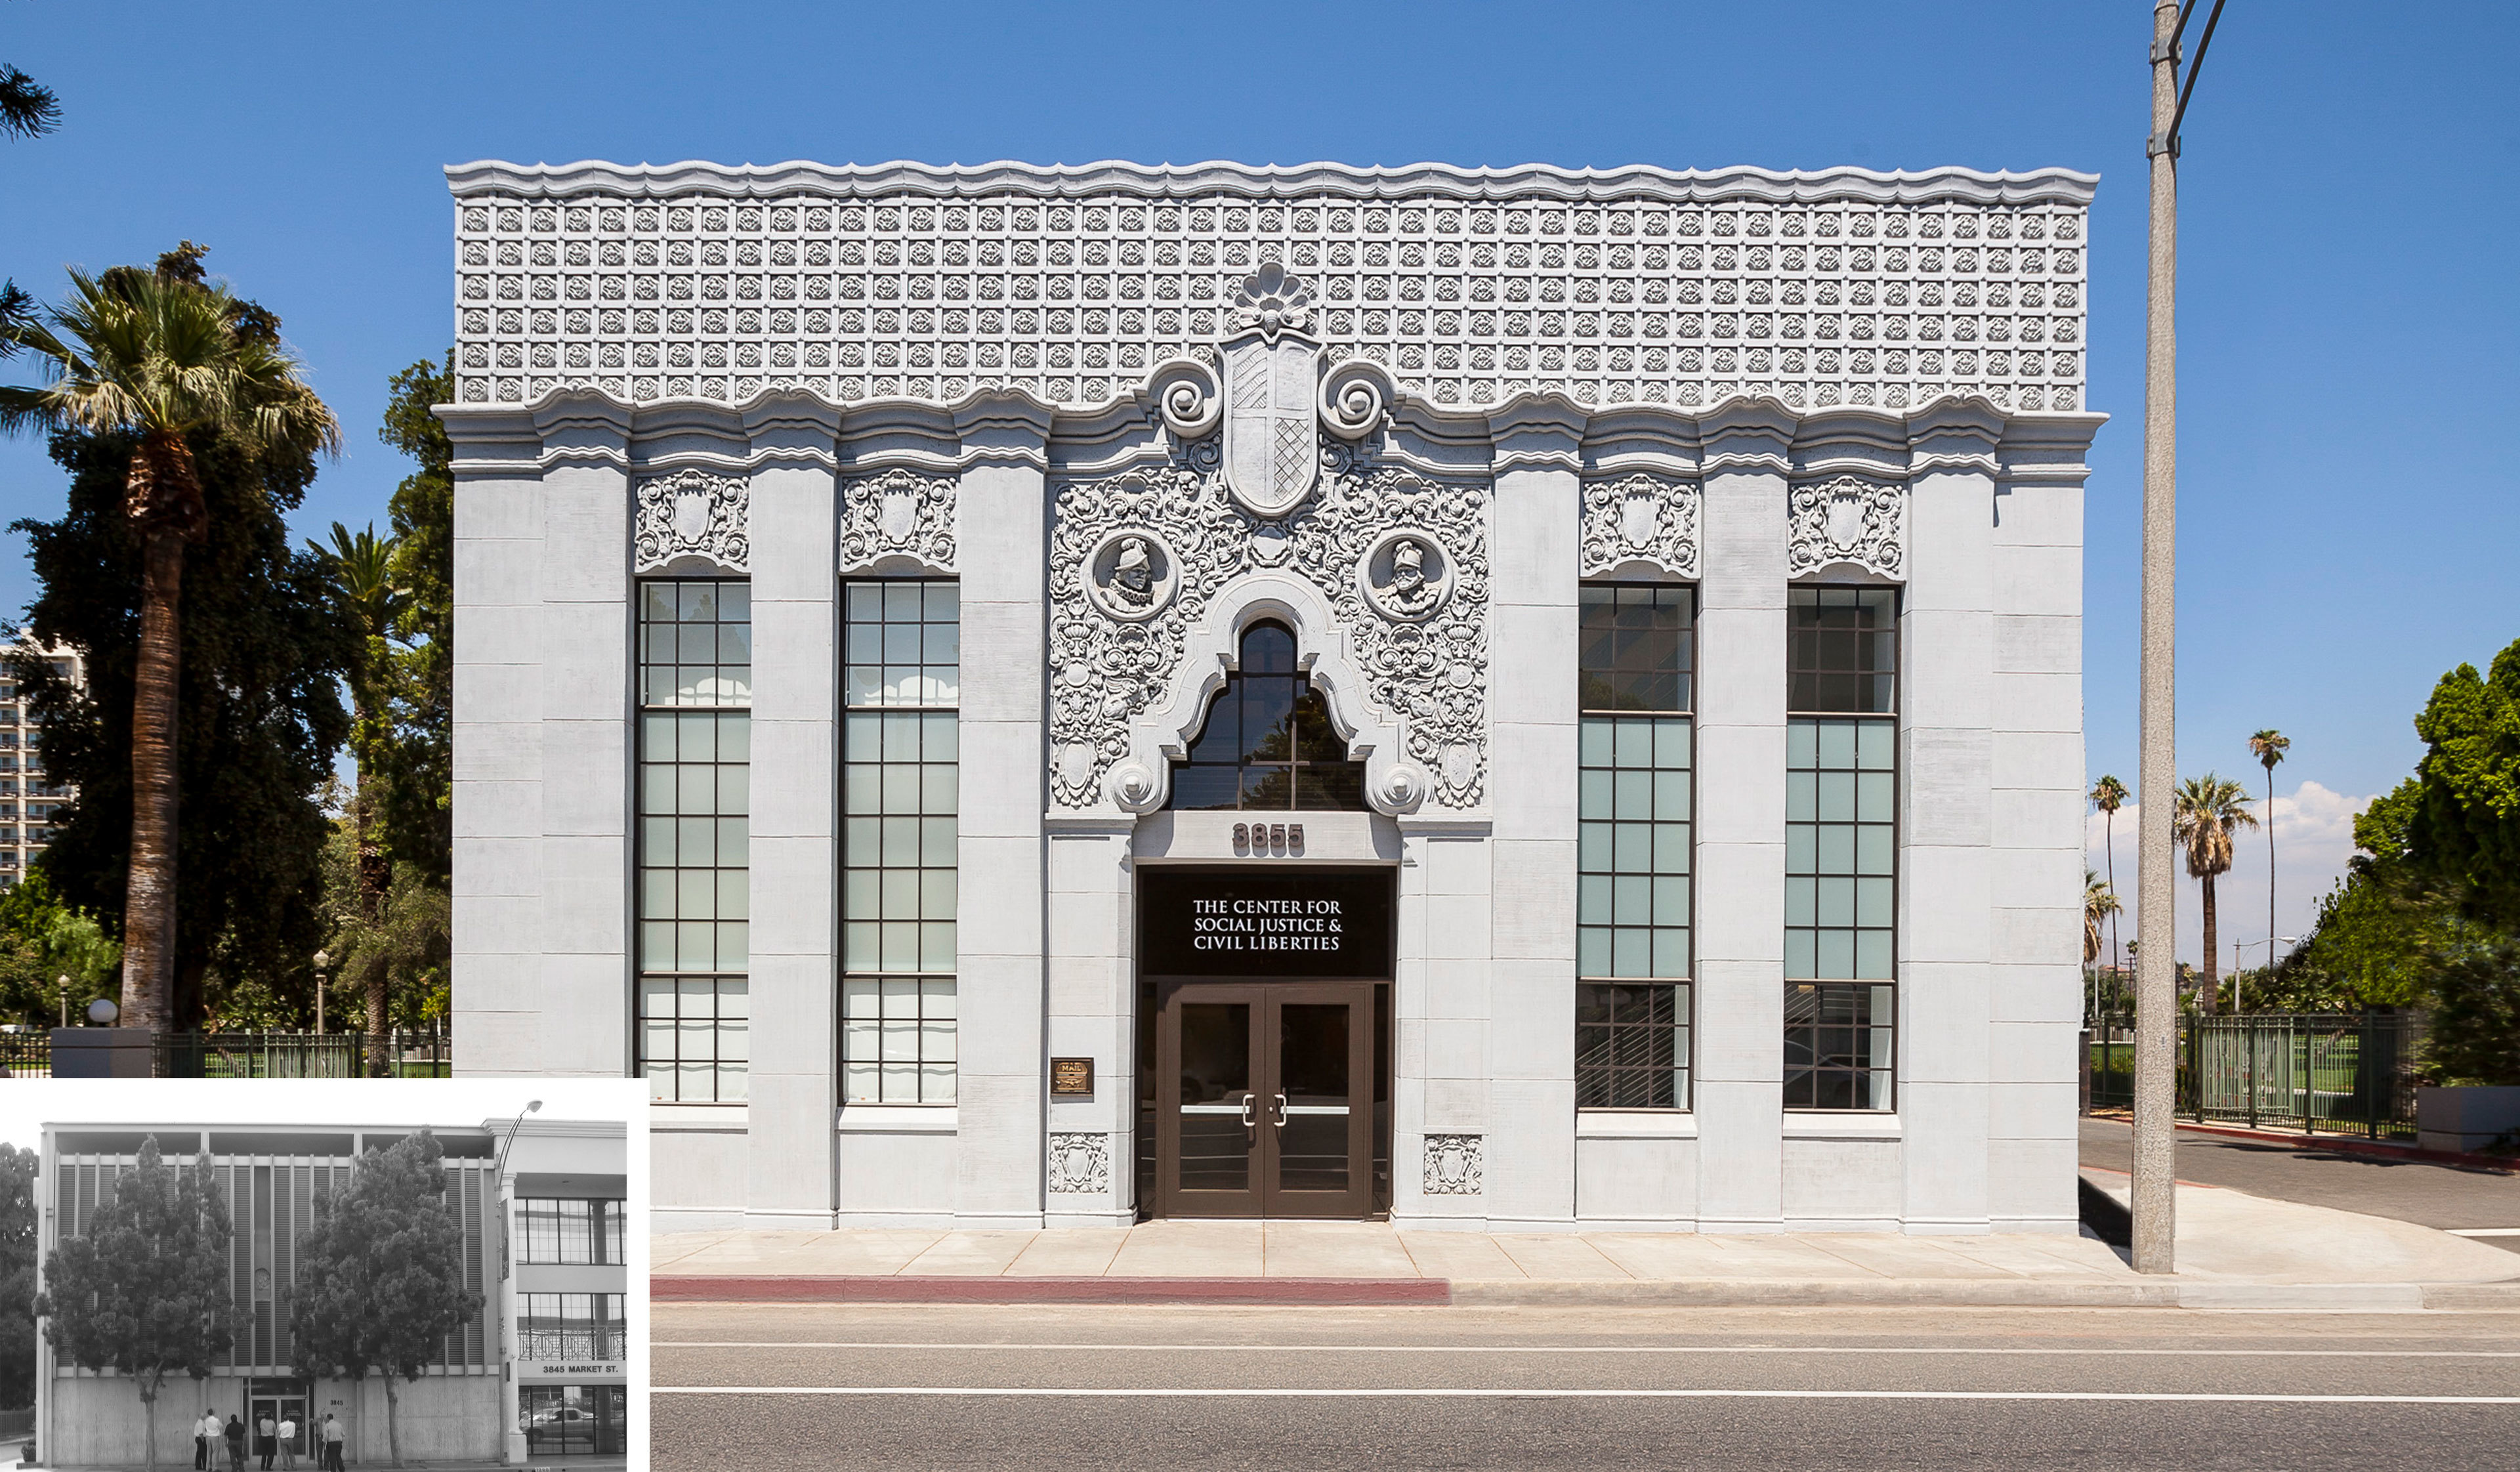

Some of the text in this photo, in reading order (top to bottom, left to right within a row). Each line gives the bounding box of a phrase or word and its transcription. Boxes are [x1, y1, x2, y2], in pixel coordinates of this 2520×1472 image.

[1232, 822, 1303, 847] 3855
[1193, 900, 1342, 914] THE CENTER FOR
[1194, 917, 1343, 935] SOCIAL JUSTICE &
[1194, 936, 1339, 950] CIVIL LIBERTIES
